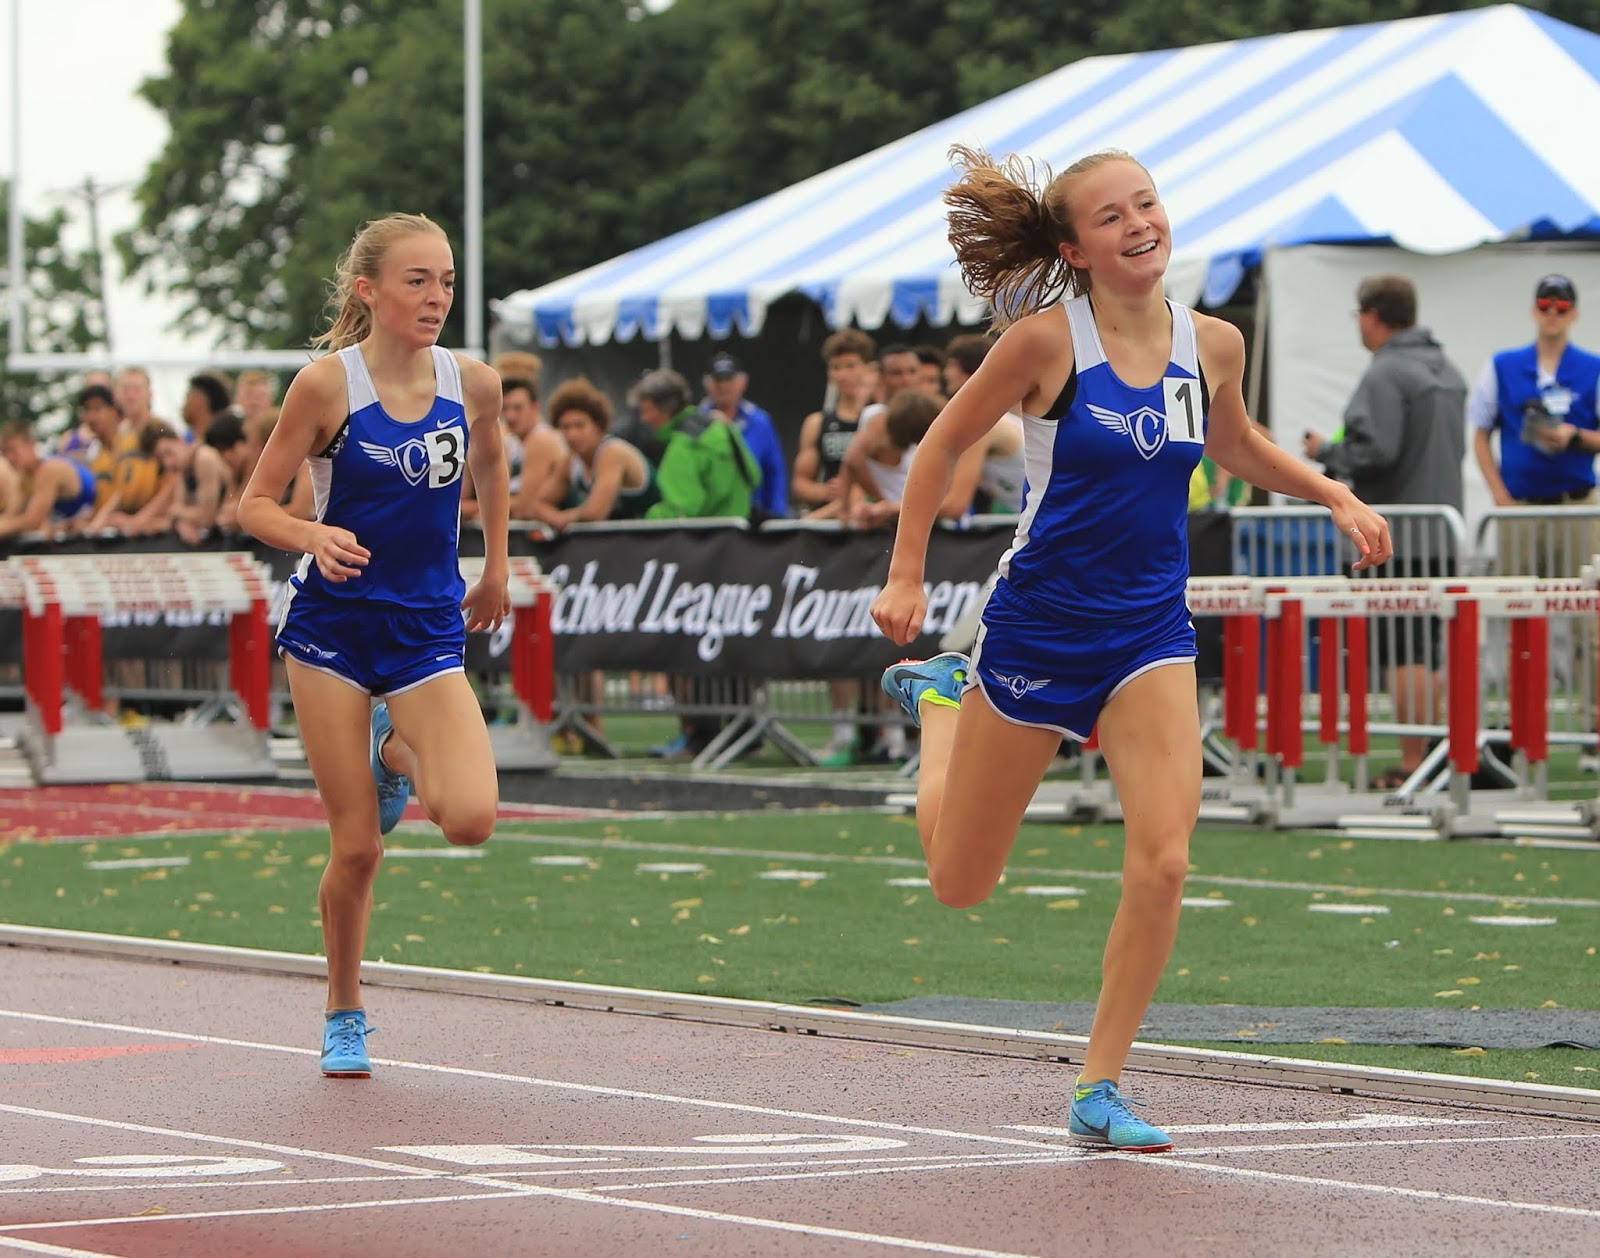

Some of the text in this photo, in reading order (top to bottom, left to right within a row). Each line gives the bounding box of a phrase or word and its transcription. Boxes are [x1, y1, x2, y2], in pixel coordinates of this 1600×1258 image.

[1175, 383, 1196, 439] 1
[434, 432, 459, 484] 3
[640, 561, 772, 662] League
[771, 563, 980, 641] Tournen
